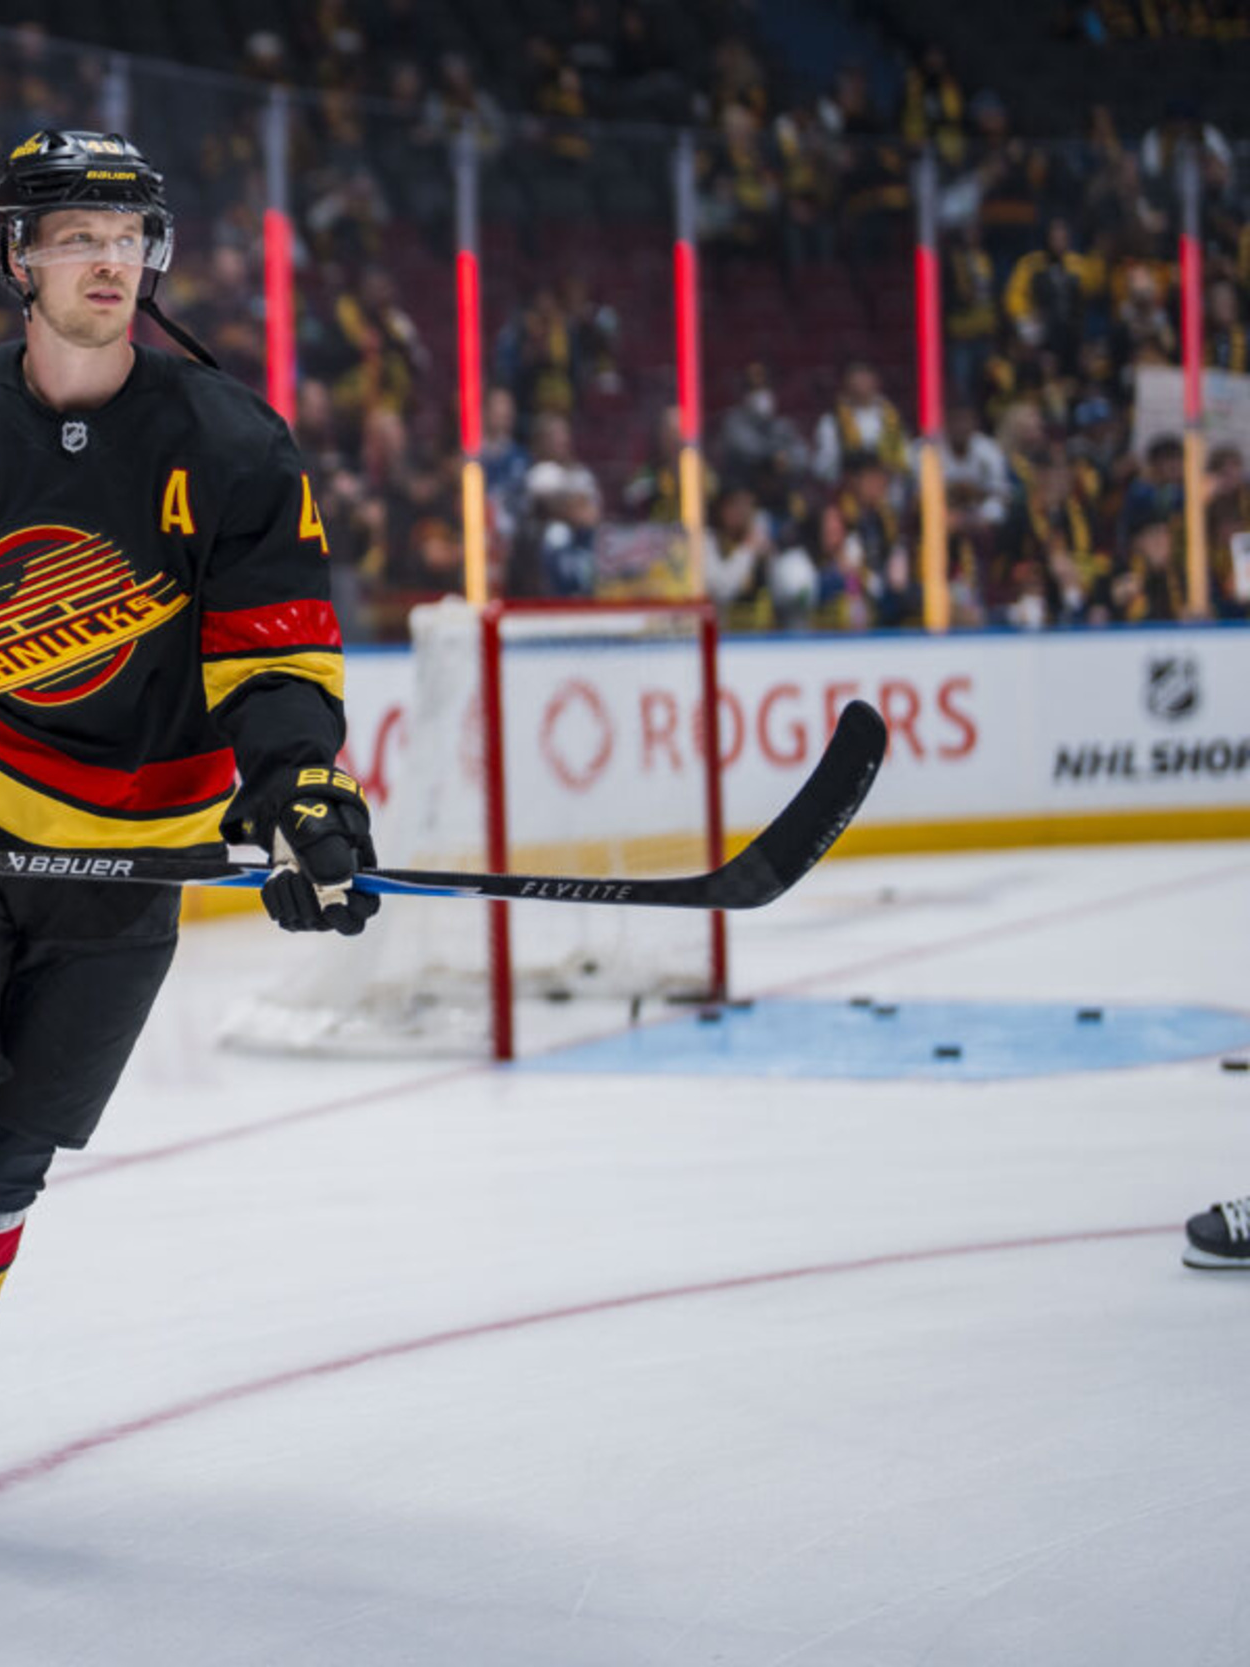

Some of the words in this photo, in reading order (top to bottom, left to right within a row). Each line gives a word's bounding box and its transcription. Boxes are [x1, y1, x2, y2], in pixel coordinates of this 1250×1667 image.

[86, 170, 137, 181] BAUER
[160, 467, 197, 535] A
[298, 471, 330, 556] 4
[1053, 744, 1136, 780] NHL
[28, 856, 134, 877] BAUER
[520, 881, 632, 899] FLYLITE
